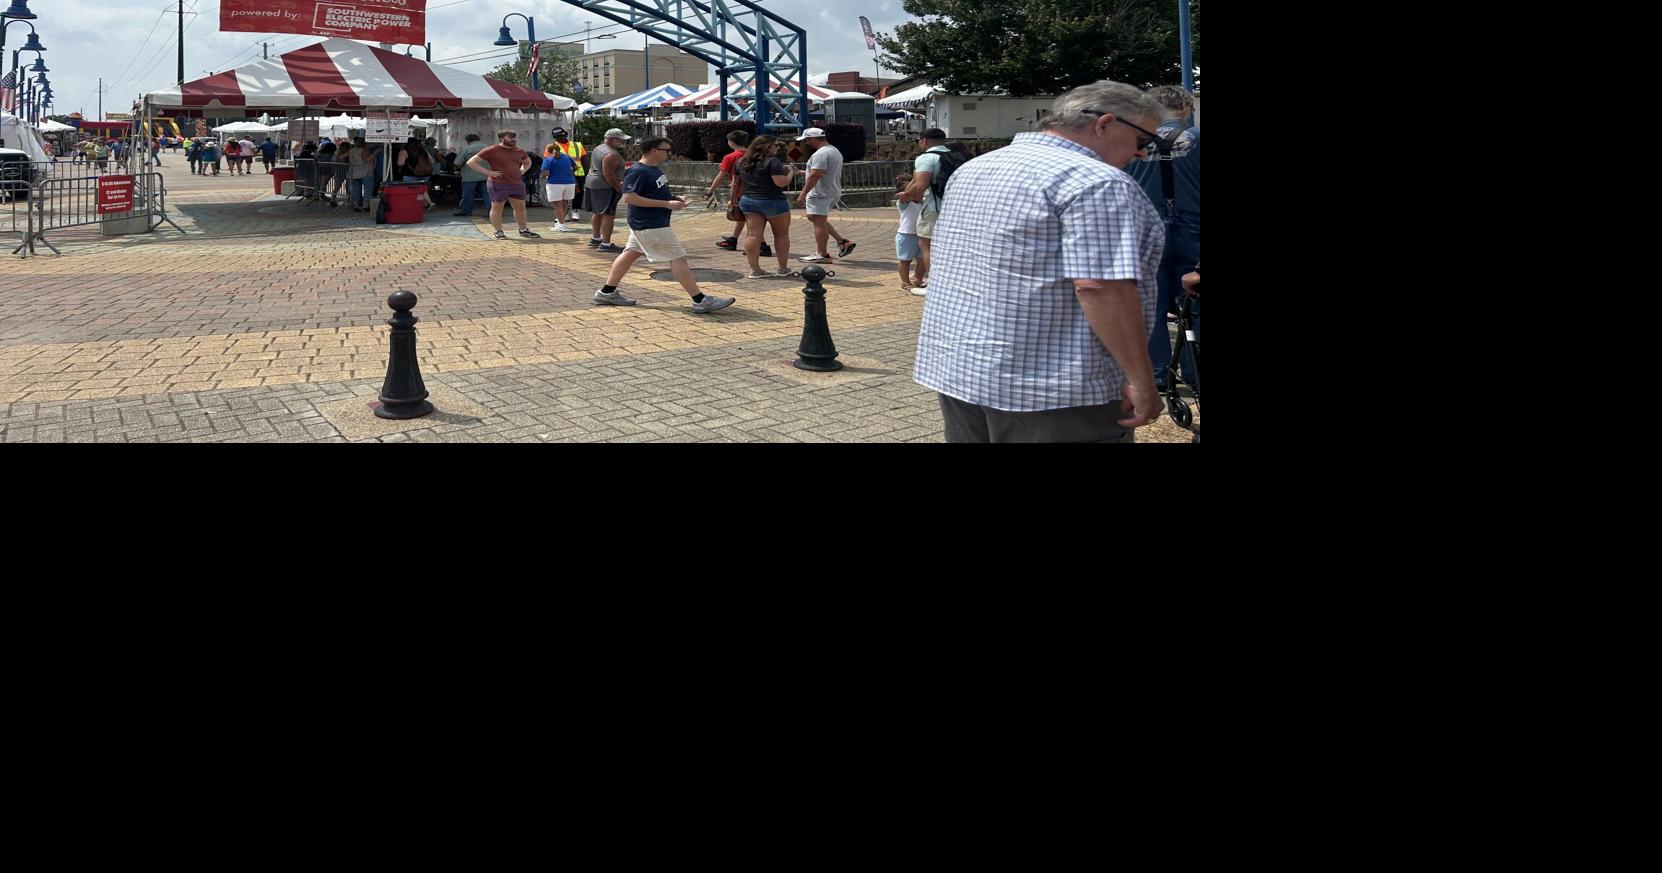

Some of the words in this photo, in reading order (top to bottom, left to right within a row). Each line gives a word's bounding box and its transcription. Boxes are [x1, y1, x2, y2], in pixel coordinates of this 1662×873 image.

[231, 9, 281, 18] powered
[326, 7, 410, 22] SOUTHWESTERN
[324, 20, 378, 30] COMPANY
[325, 13, 372, 24] ELECTRIC
[373, 19, 411, 27] POWER
